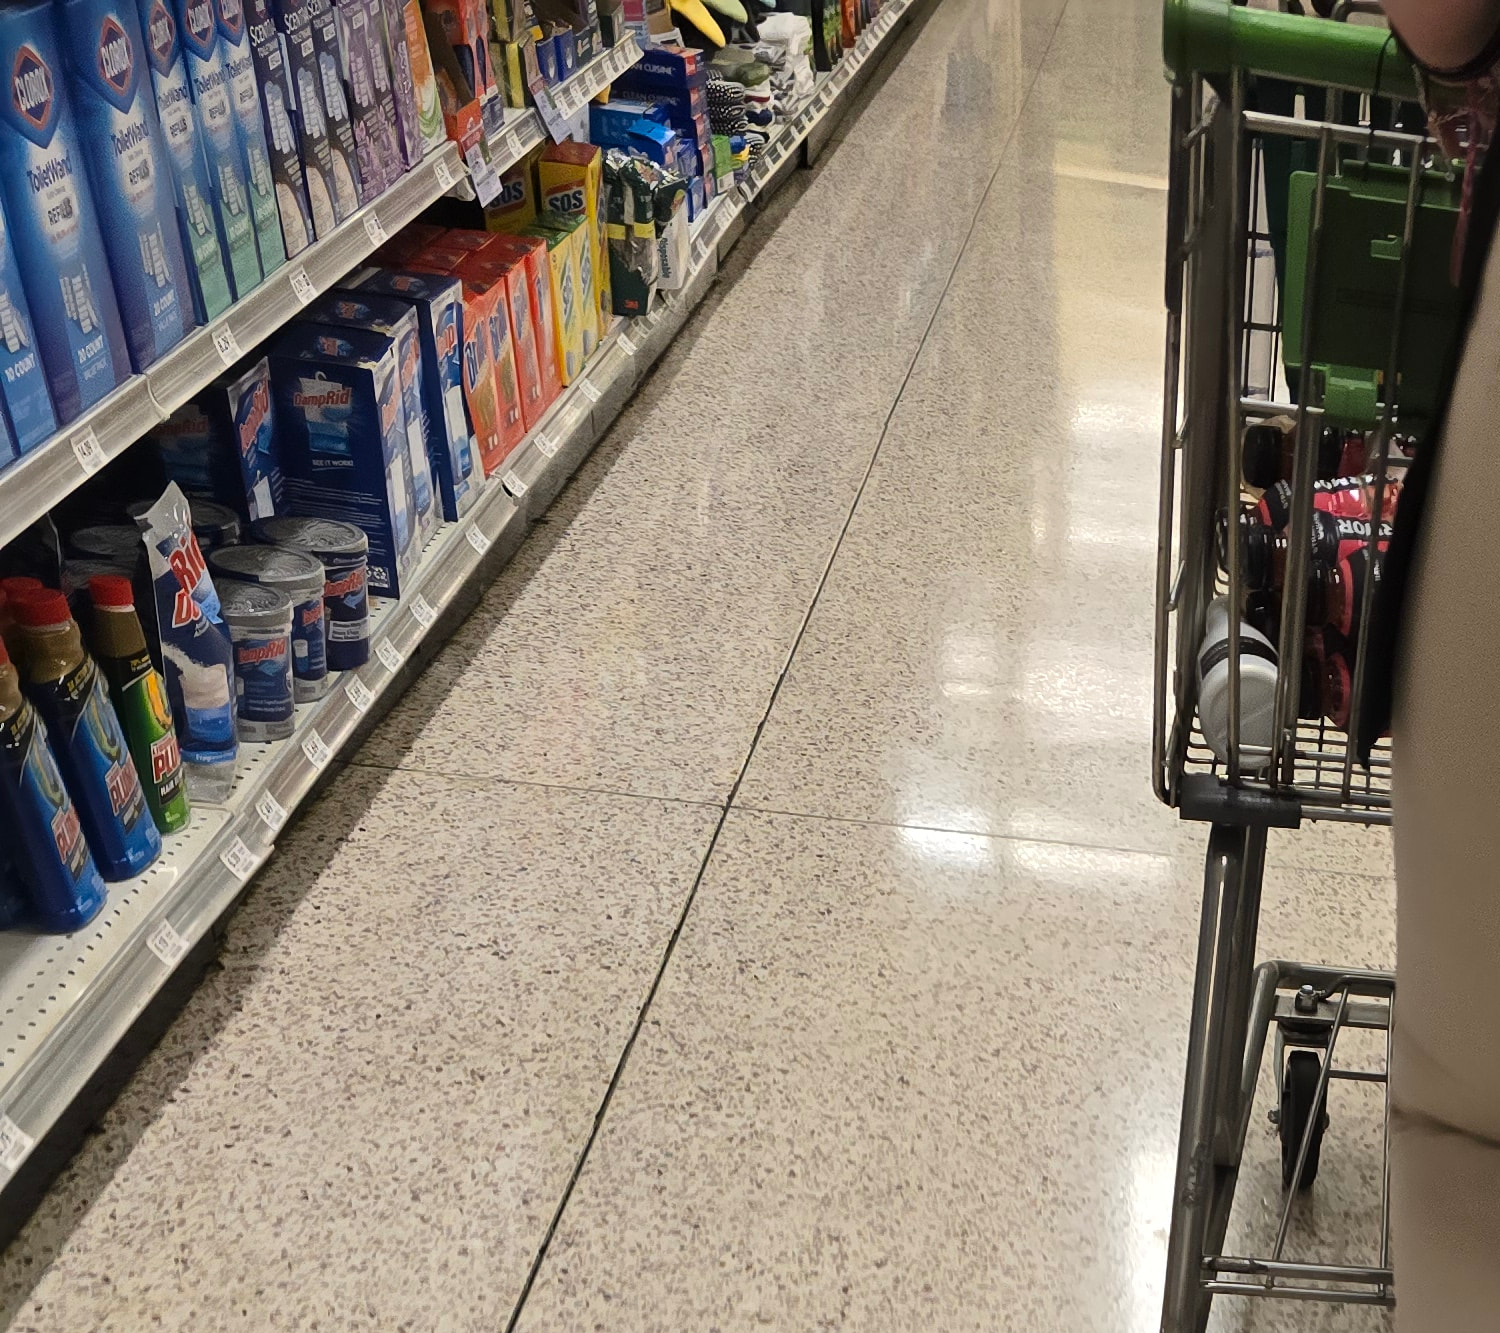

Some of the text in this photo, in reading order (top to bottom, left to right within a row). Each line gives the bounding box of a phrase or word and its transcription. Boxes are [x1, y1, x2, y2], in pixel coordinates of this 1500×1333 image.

[26, 149, 73, 195] ToiletWand
[548, 190, 584, 213] SOS
[293, 387, 353, 408] DampRid
